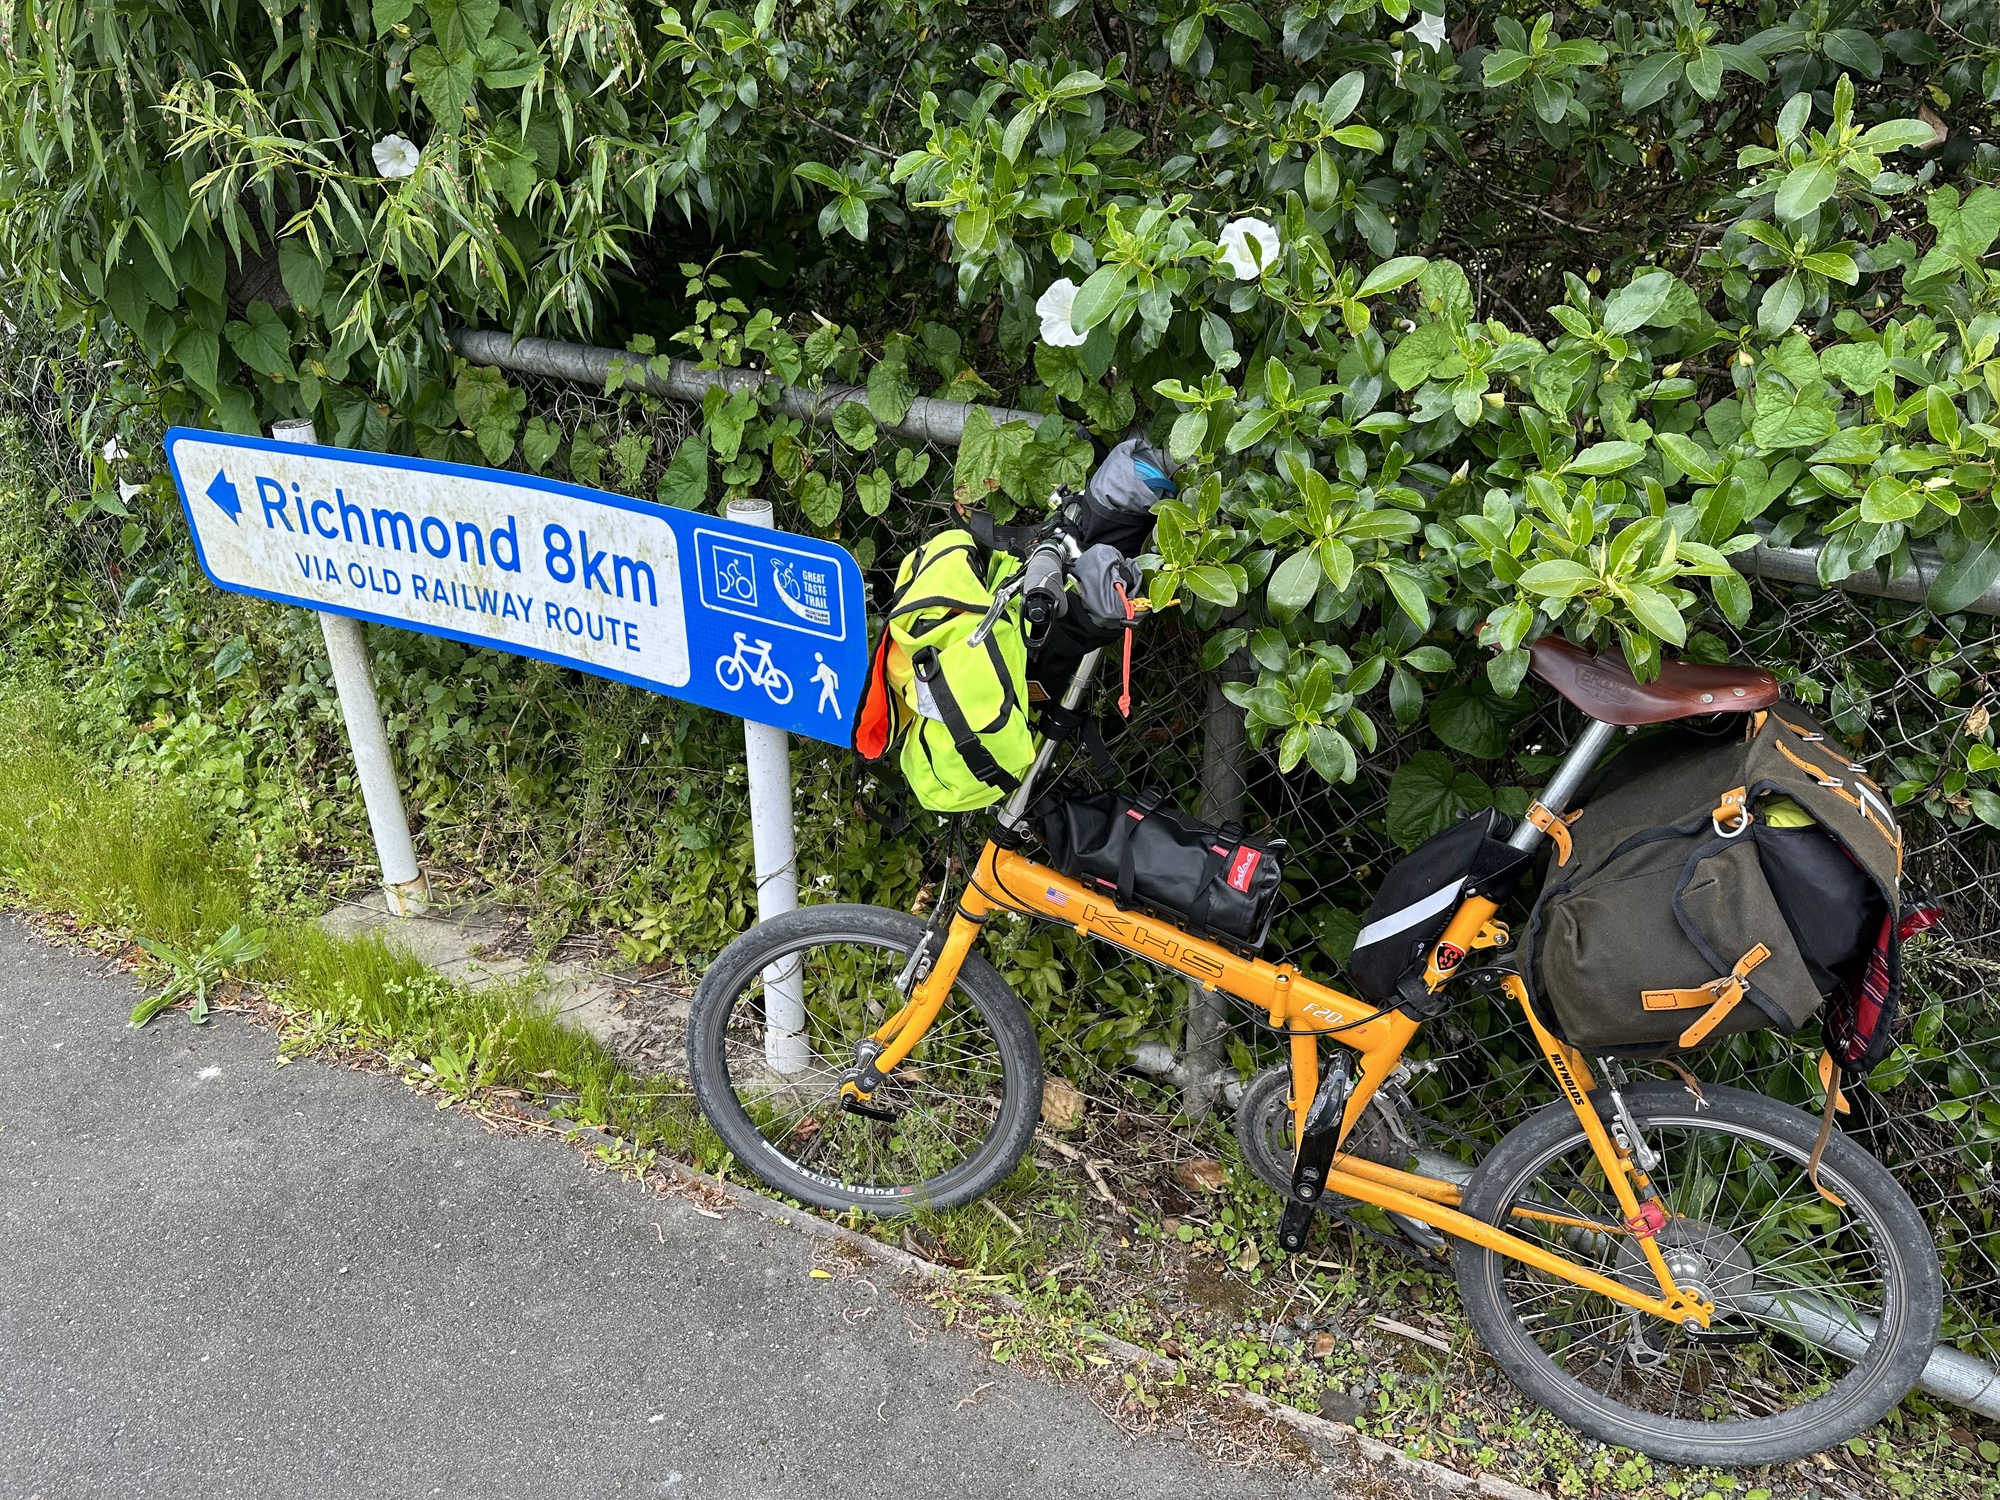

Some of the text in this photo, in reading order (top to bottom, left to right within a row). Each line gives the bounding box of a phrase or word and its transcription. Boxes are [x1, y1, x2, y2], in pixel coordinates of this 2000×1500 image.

[255, 475, 659, 608] Richmond 8km
[802, 569, 825, 584] GREAT
[803, 581, 827, 597] TASTE
[295, 552, 642, 654] VIA OLD RAILWAY ROUTE
[804, 593, 828, 609] TRAIL
[1580, 667, 1635, 698] BROOKS
[1233, 851, 1257, 890] Salsa
[1082, 903, 1225, 979] KHS
[1550, 1053, 1585, 1106] REYNOLDS
